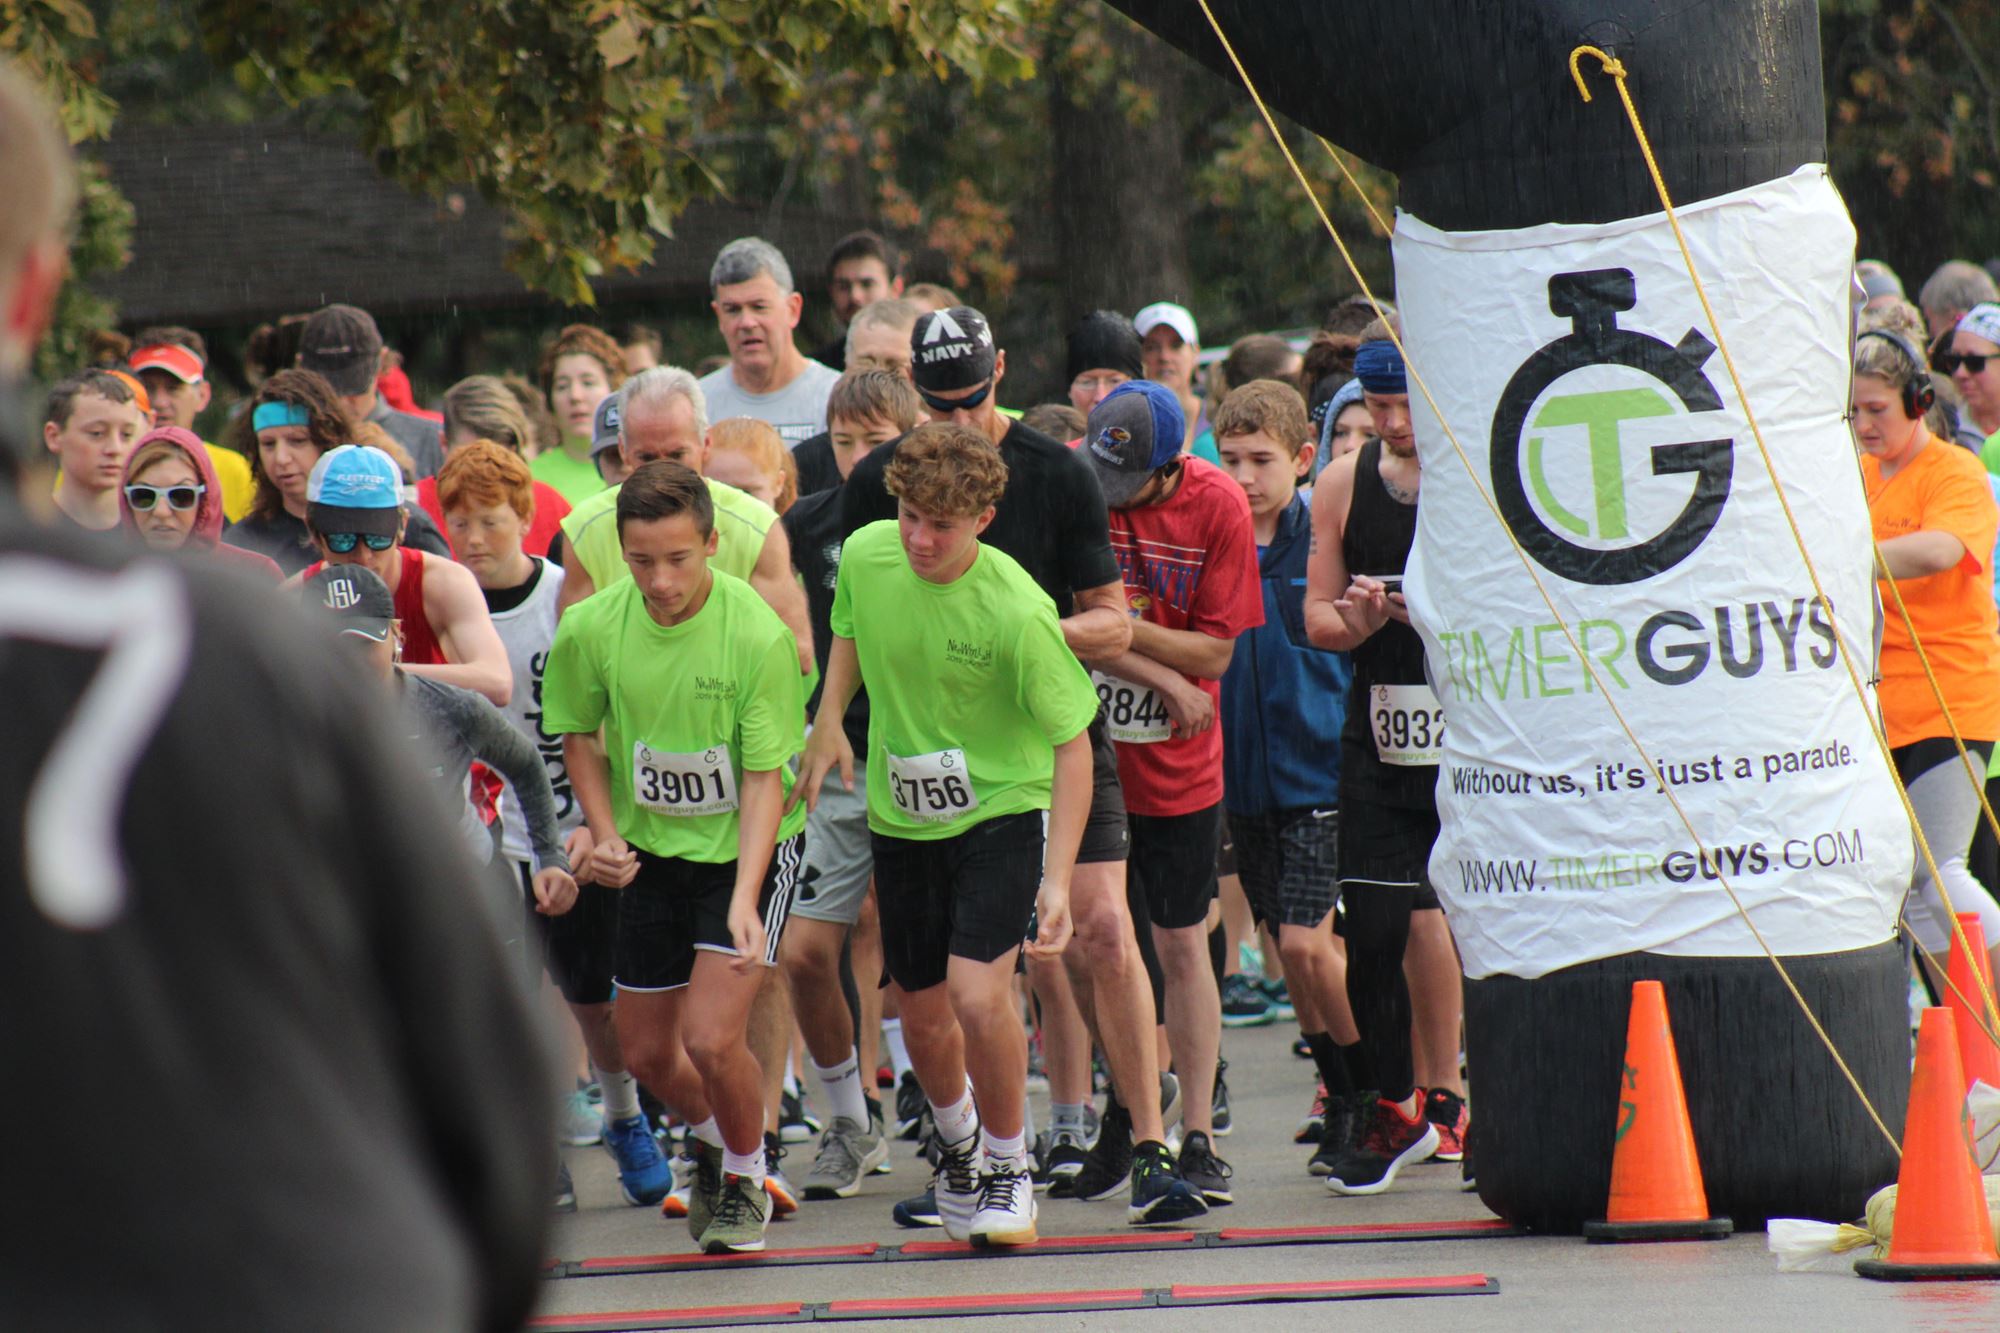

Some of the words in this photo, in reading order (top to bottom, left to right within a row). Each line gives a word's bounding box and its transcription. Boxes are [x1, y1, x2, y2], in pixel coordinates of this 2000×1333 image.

[921, 342, 974, 363] NAVY
[323, 578, 361, 609] JSL
[1438, 594, 1839, 702] TIMERGUYS
[1376, 709, 1444, 749] 3932
[641, 766, 726, 804] 3901
[1452, 767, 1531, 794] Without
[1539, 774, 1586, 798] us,
[1596, 763, 1646, 792] it's
[1656, 754, 1724, 794] just
[1734, 756, 1753, 779] a
[1763, 739, 1858, 783] parade.
[891, 771, 969, 812] 3756
[1459, 828, 1864, 893] WWW.TIMERGUYS.COM
